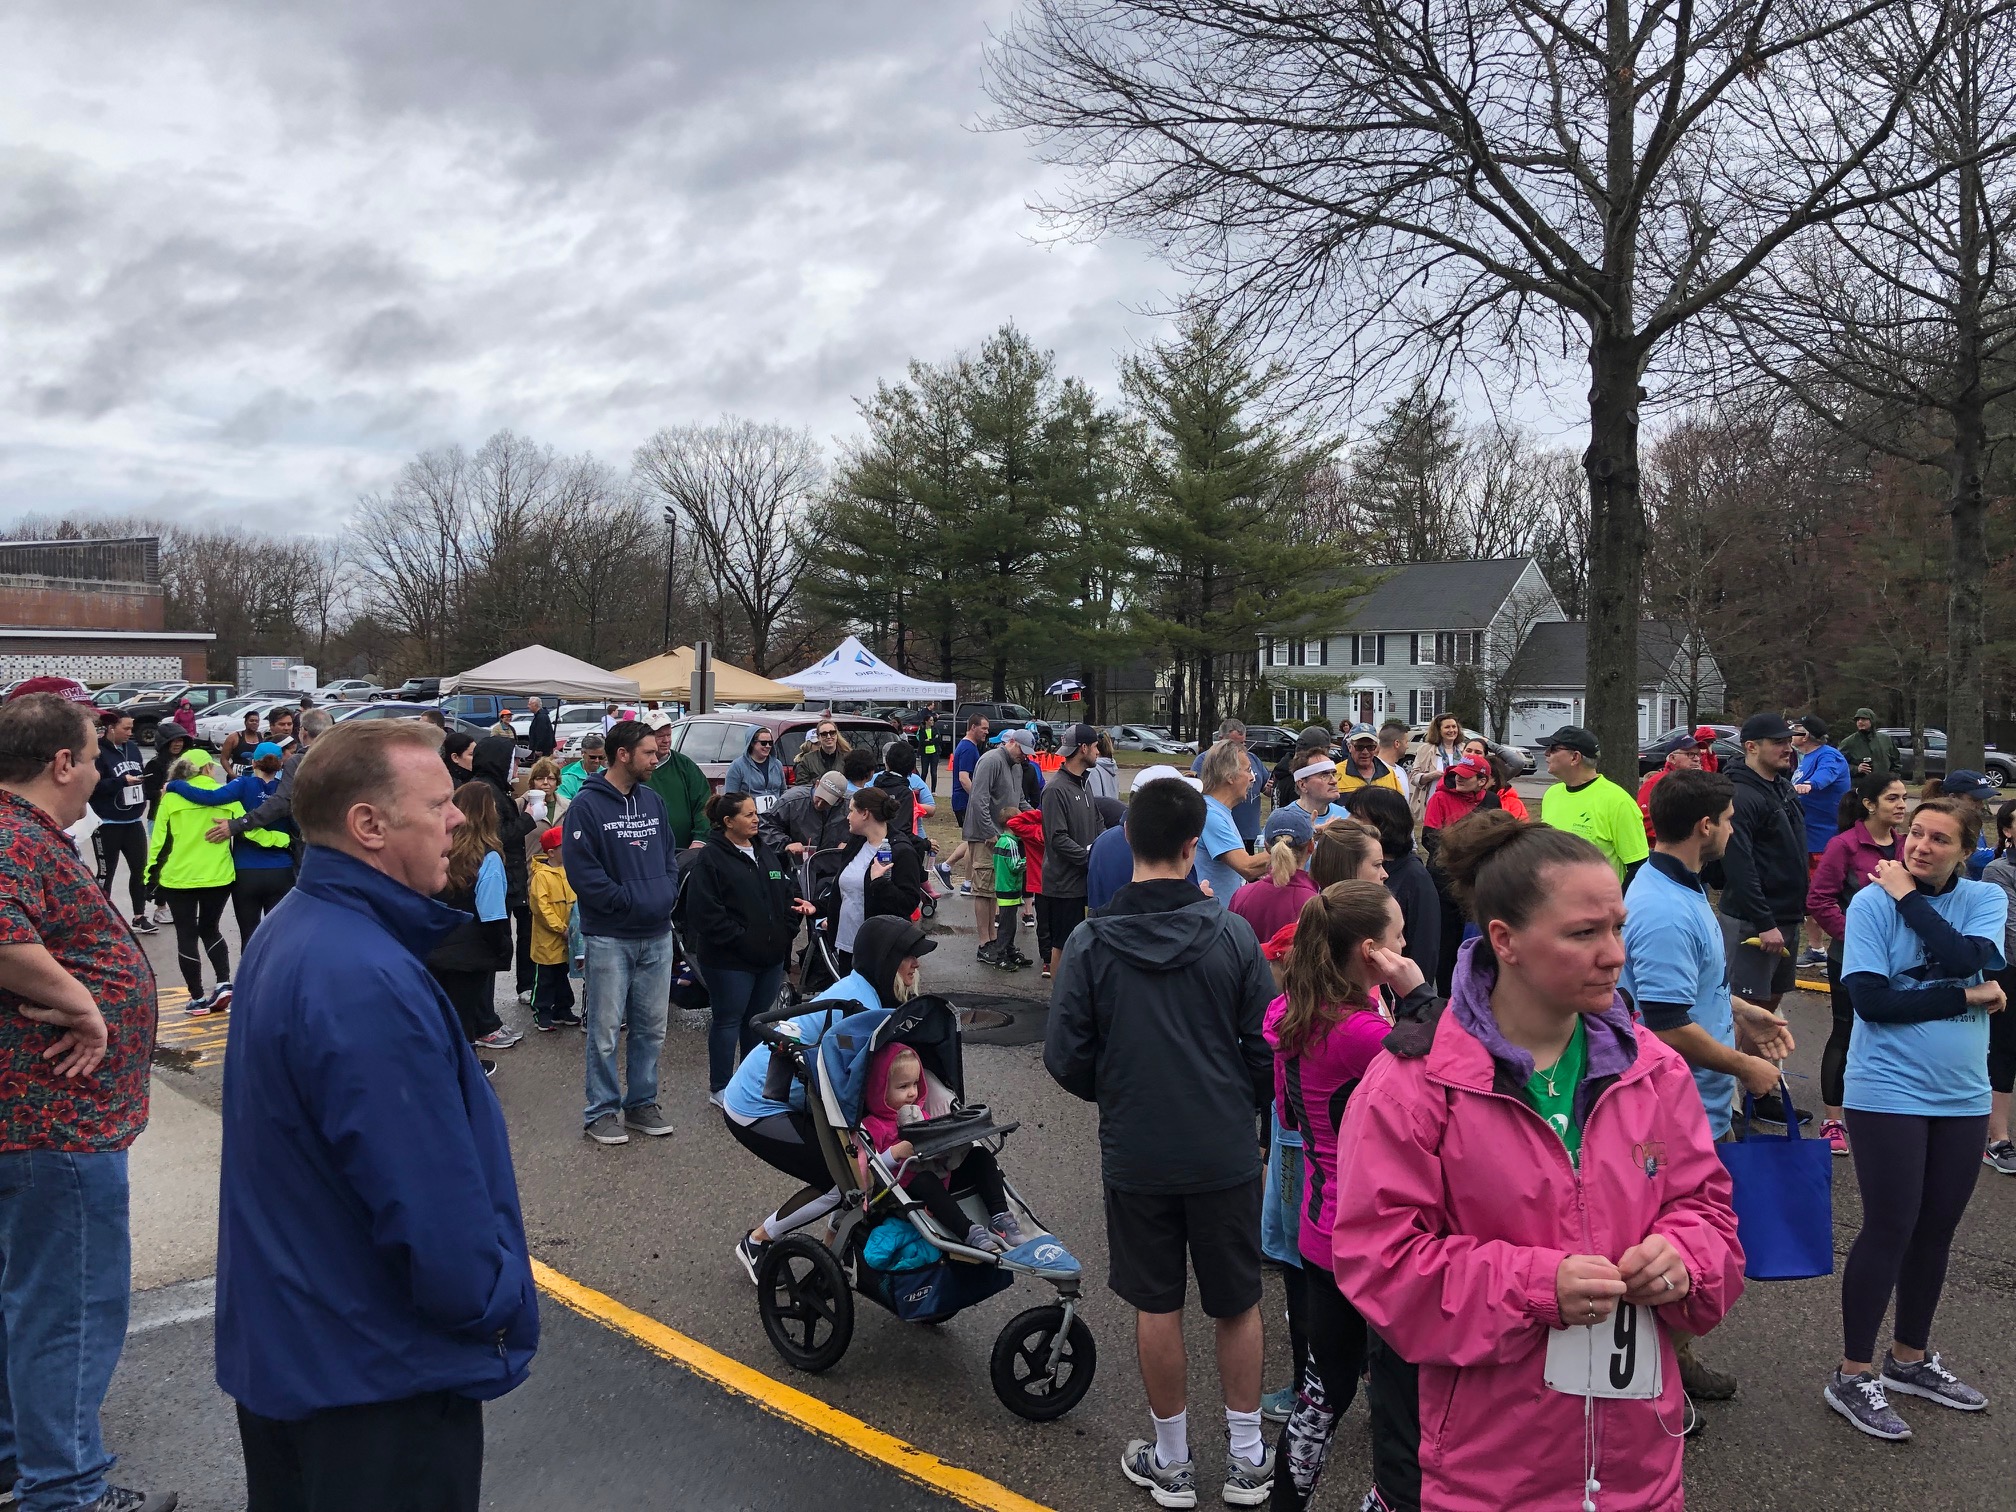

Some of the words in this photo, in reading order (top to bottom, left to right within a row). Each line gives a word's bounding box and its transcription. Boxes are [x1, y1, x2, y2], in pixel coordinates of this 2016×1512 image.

[855, 670, 893, 678] DIRECT
[901, 686, 919, 694] RATE
[763, 796, 774, 810] 12
[603, 821, 625, 831] NEW
[626, 818, 660, 829] ENGLAND
[617, 827, 657, 838] PATRIOTS
[1960, 1014, 1976, 1023] 2019
[1609, 1299, 1637, 1389] 9
